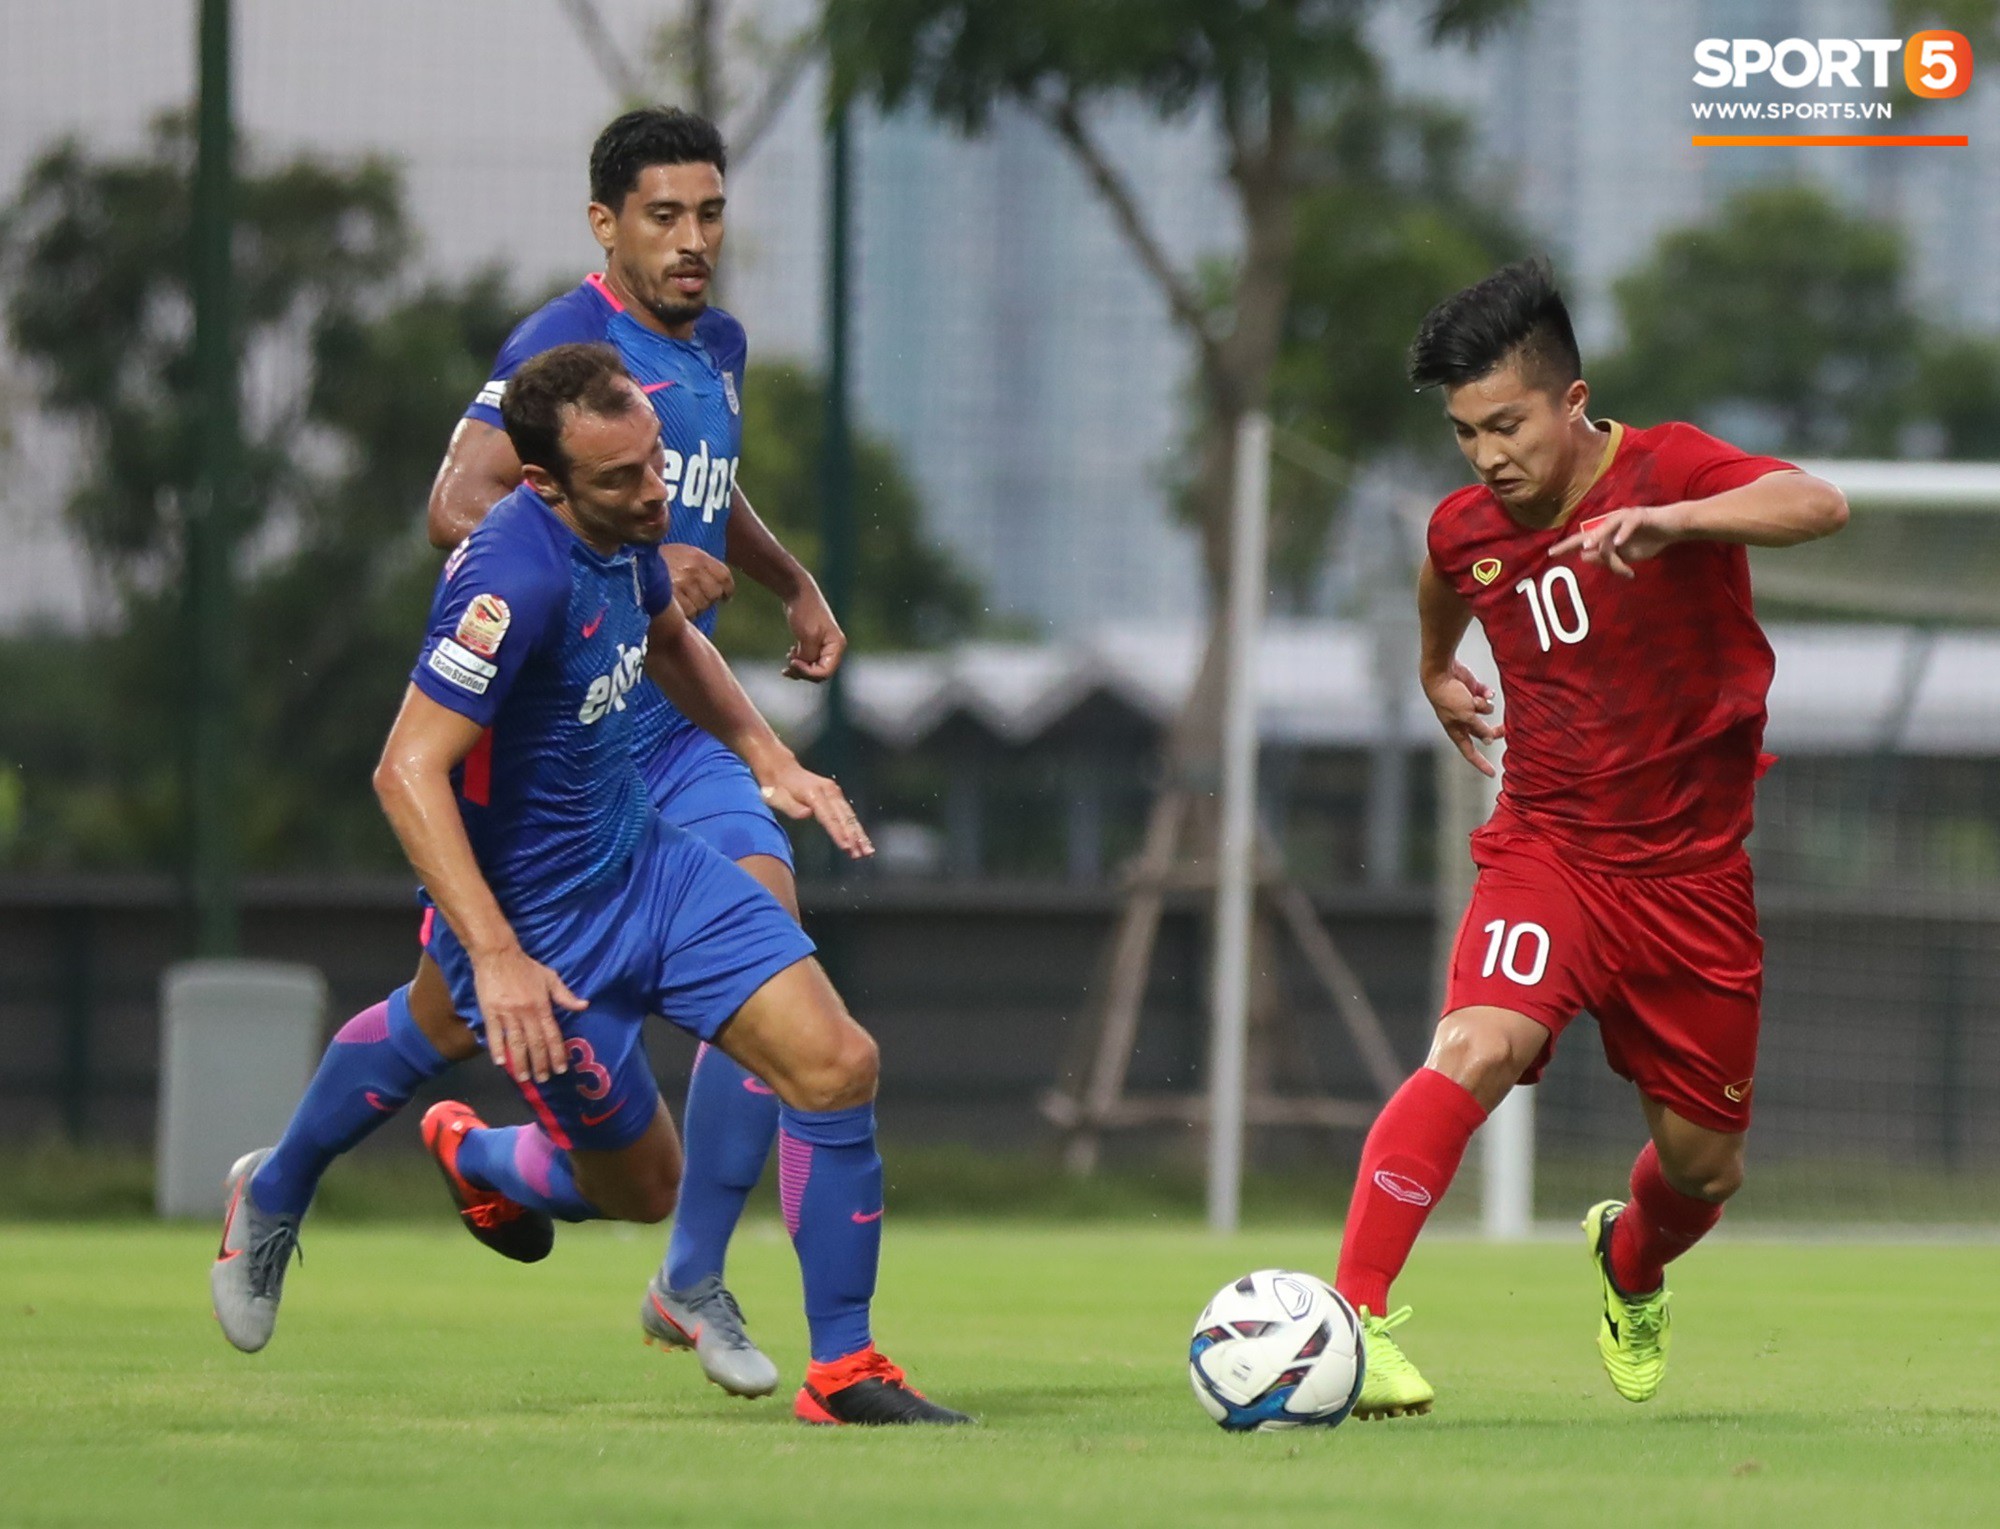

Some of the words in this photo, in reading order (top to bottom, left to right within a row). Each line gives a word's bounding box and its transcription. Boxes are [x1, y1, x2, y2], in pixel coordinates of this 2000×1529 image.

[1515, 565, 1590, 653] 10
[1481, 918, 1550, 986] 10
[564, 1037, 612, 1100] 3
